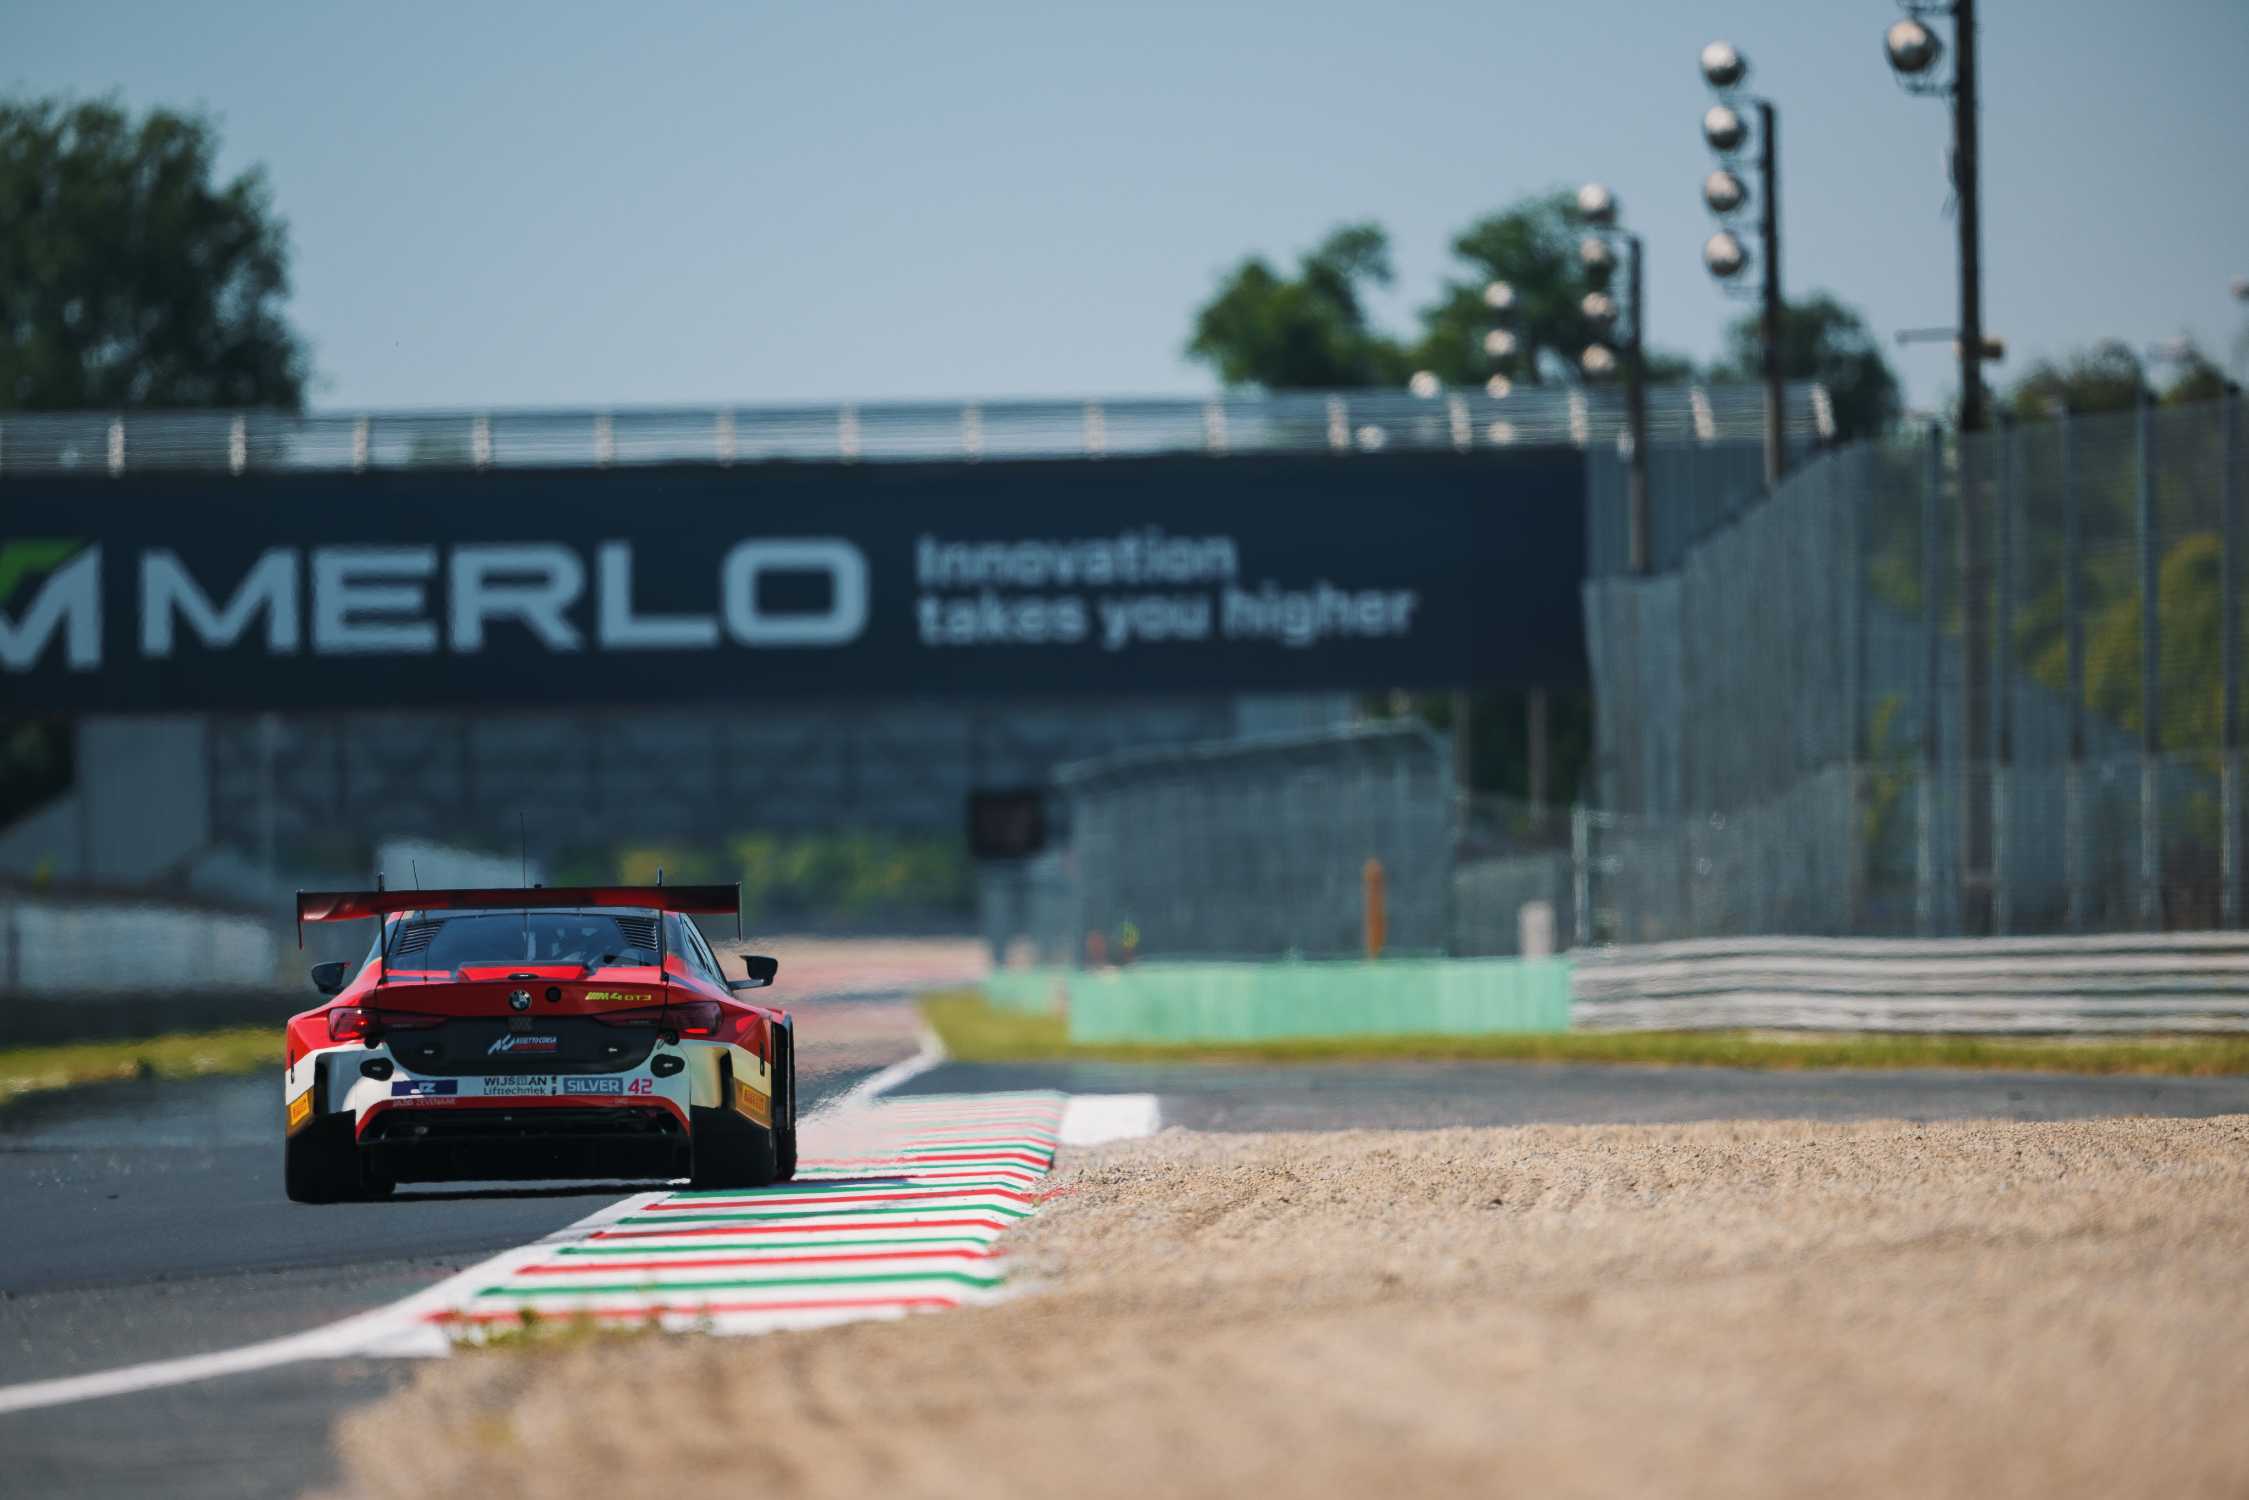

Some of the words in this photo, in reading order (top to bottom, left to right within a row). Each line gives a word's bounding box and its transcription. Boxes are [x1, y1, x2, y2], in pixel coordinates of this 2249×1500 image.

[917, 527, 1237, 585] Innovation
[139, 538, 870, 656] MERLO
[917, 588, 1086, 644] takes
[1102, 596, 1210, 650] you
[1221, 578, 1414, 647] higher
[567, 1080, 620, 1092] SILVER
[628, 1078, 653, 1094] 42
